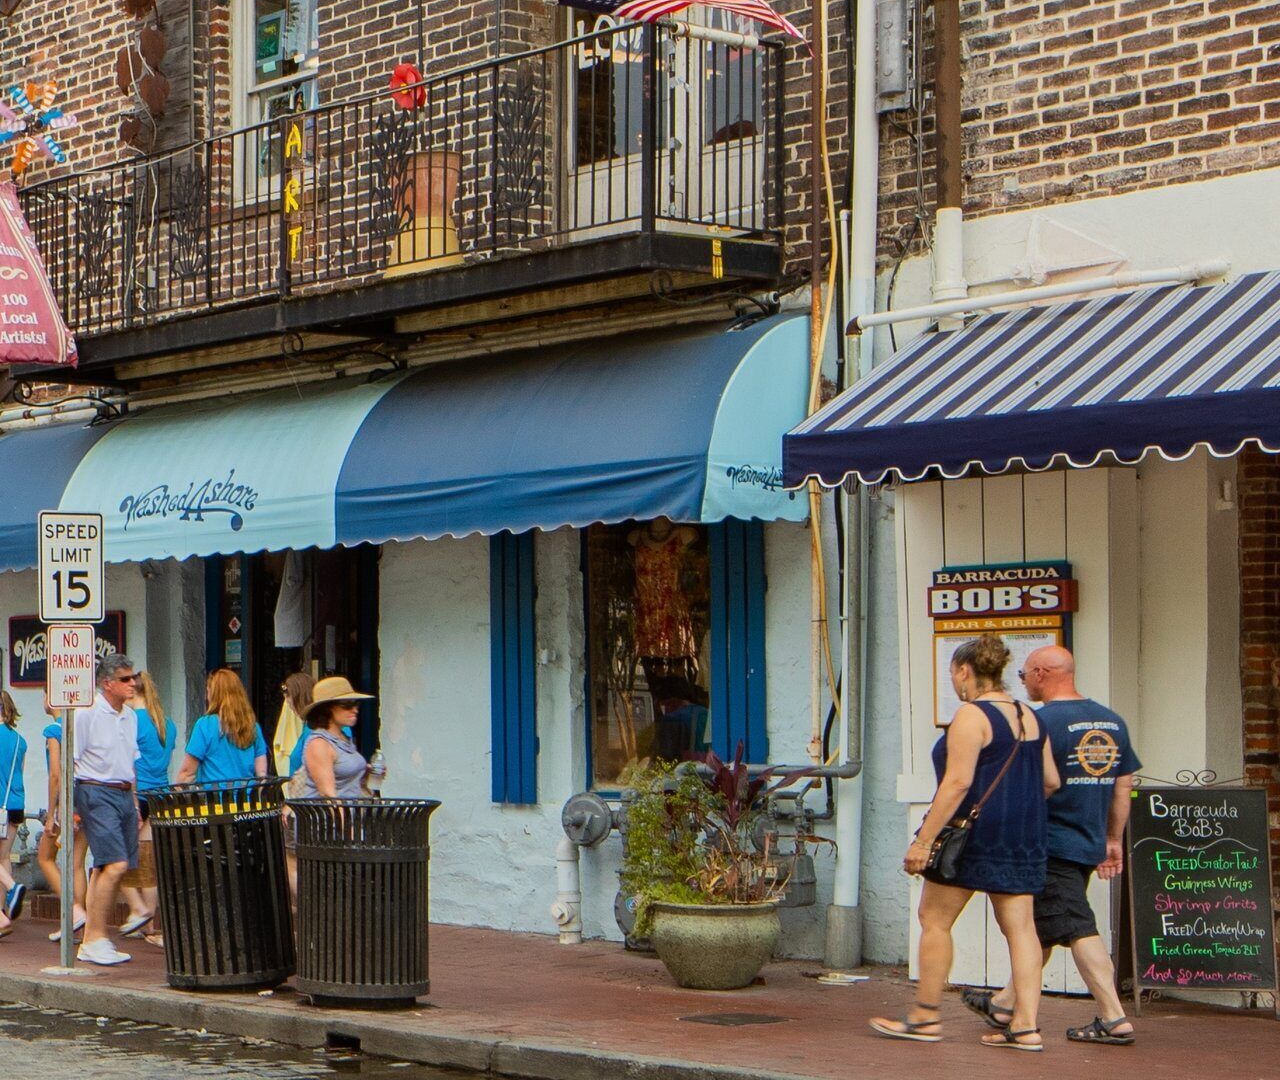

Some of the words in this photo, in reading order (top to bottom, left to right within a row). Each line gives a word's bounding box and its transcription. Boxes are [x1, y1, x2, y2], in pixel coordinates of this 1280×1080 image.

[2, 294, 28, 306] 100
[1, 312, 38, 325] Local
[0, 331, 47, 345] Artists!
[119, 482, 194, 531] Washed
[179, 468, 259, 532] Ashore
[45, 523, 98, 539] SPEED
[51, 547, 92, 563] LIMIT
[936, 567, 1060, 584] BARRACUDA
[52, 570, 91, 609] 15
[931, 584, 1059, 614] BOB'S
[943, 621, 979, 630] BAR
[984, 620, 997, 628] &
[1002, 618, 1053, 628] GRILL
[63, 632, 79, 648] NO
[52, 654, 91, 669] PARKING
[63, 675, 80, 685] ANY
[62, 691, 80, 701] TIME
[1149, 794, 1238, 818] Barracuda
[173, 818, 208, 826] RECYCLES
[233, 810, 271, 822] SAVANNAH
[1197, 851, 1234, 870] Gator
[1230, 851, 1258, 870] Tail
[1164, 874, 1216, 894] Guinness
[1217, 876, 1253, 892] Wings
[1154, 893, 1212, 914] Shrimp
[1223, 895, 1257, 910] Grits
[1193, 917, 1239, 940] Chicken
[1236, 921, 1266, 939] Wrap
[1152, 937, 1181, 955] Fried
[1183, 943, 1215, 958] Green
[1240, 945, 1260, 955] BLT
[1143, 964, 1174, 982] And
